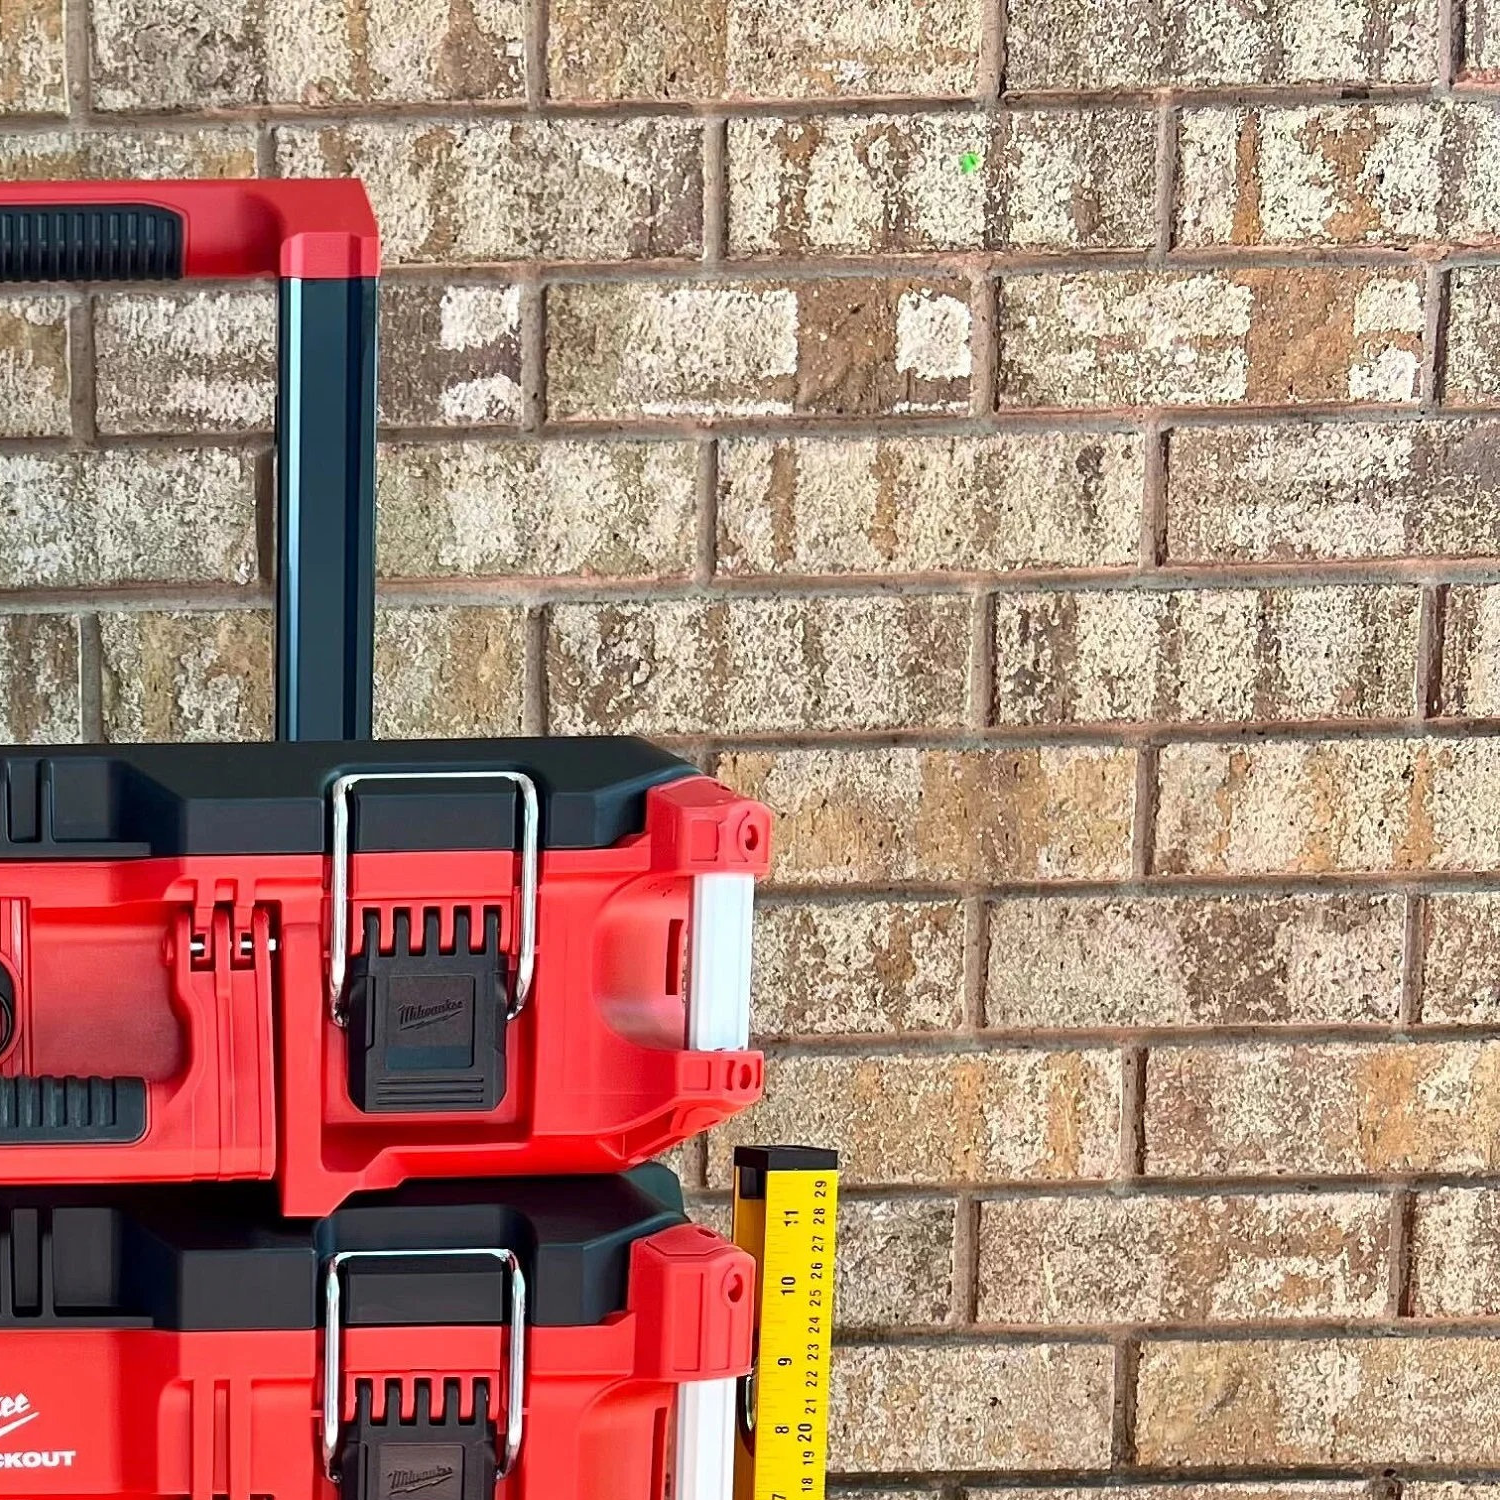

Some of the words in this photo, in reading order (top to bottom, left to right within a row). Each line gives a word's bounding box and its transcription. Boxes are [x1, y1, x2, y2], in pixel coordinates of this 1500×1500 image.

[397, 998, 464, 1024] Milwaukee
[815, 1181, 826, 1197] 29
[783, 1211, 798, 1227] 11
[813, 1208, 825, 1224] 28
[812, 1235, 823, 1252] 27
[811, 1263, 823, 1279] 26
[780, 1277, 795, 1295] 10
[809, 1290, 821, 1306] 25
[808, 1317, 820, 1333] 24
[807, 1344, 819, 1360] 23
[778, 1358, 792, 1366] 9
[806, 1371, 817, 1387] 22
[805, 1399, 816, 1414] 21
[775, 1426, 789, 1434] 8
[797, 1424, 812, 1442] 20
[803, 1451, 814, 1465] 19
[387, 1465, 453, 1490] Milwaukee
[801, 1478, 813, 1492] 18
